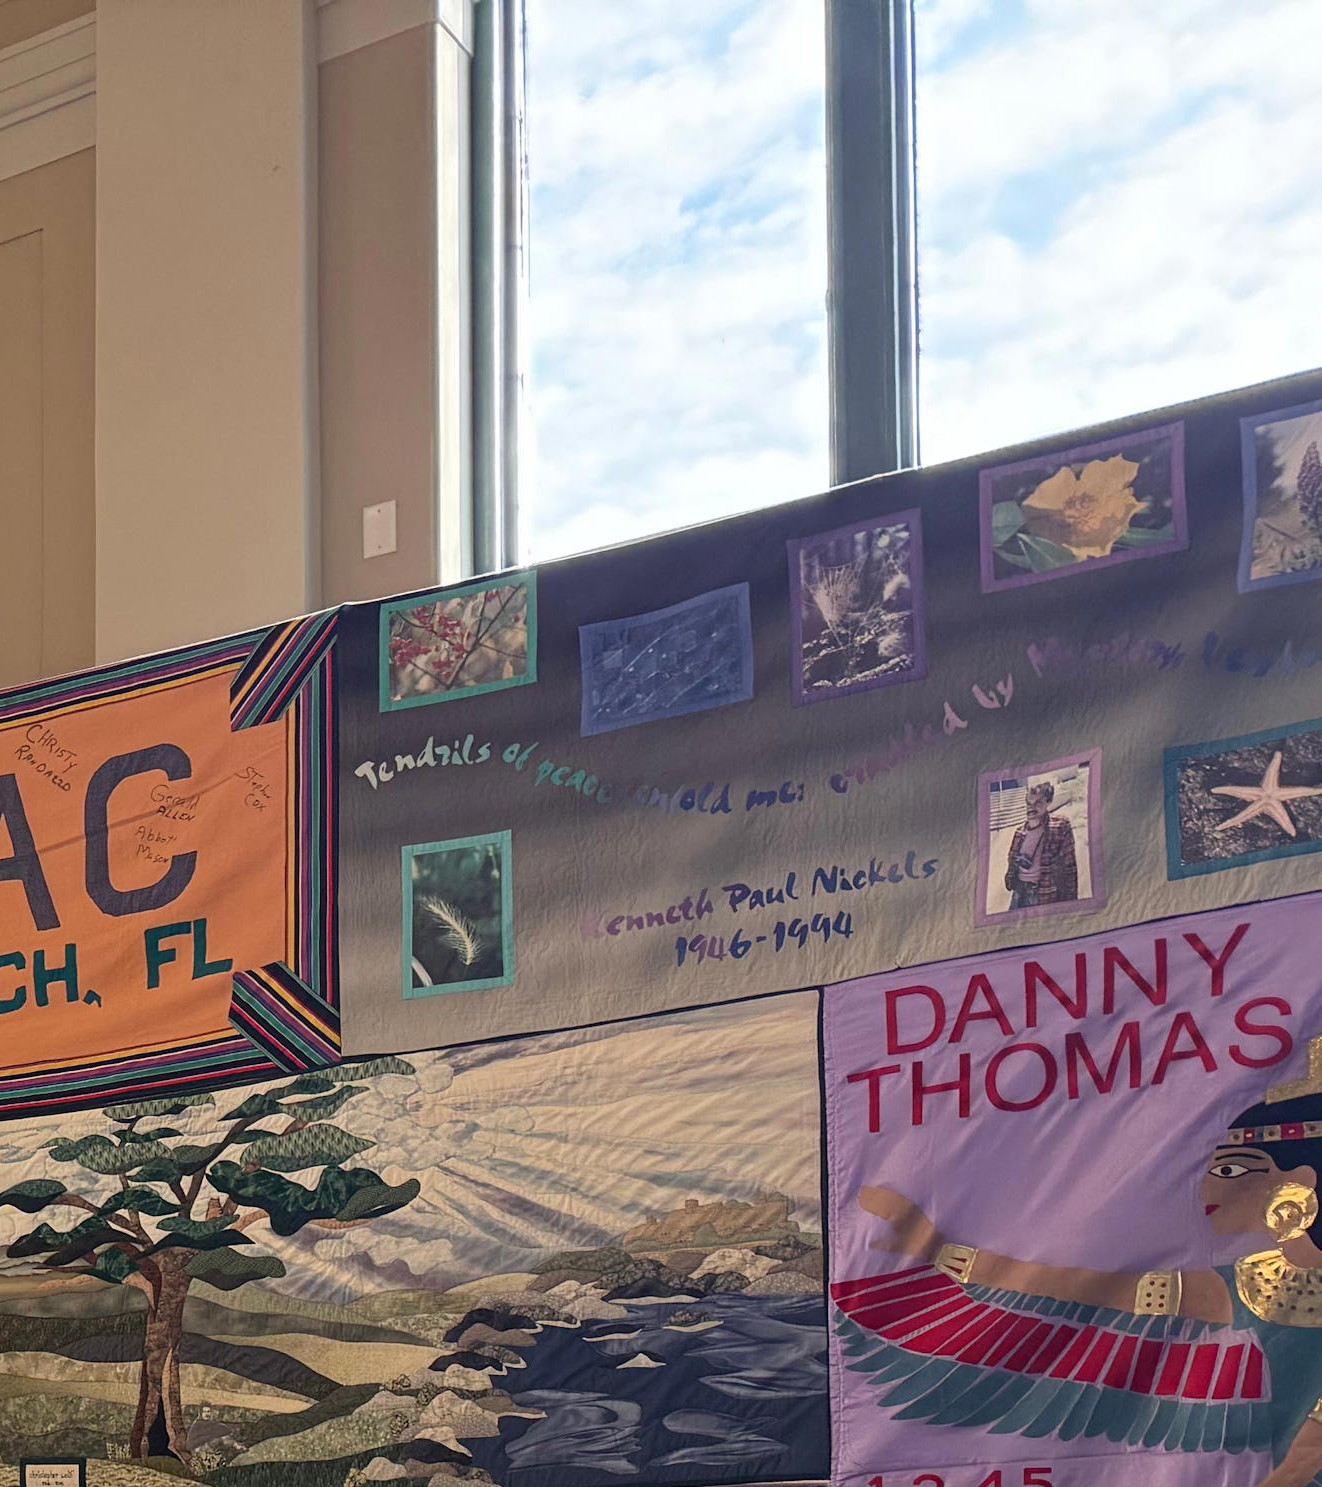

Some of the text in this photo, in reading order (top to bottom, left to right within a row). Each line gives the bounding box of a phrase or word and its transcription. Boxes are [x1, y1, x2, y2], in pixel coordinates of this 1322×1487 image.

[354, 734, 539, 790] Tendrils of
[723, 871, 796, 912] Paul
[813, 851, 942, 896] Nickels
[144, 917, 233, 989] FL
[673, 911, 854, 967] 1946-1994
[884, 923, 1252, 1057] DANNY
[845, 995, 1295, 1134] THOMAS
